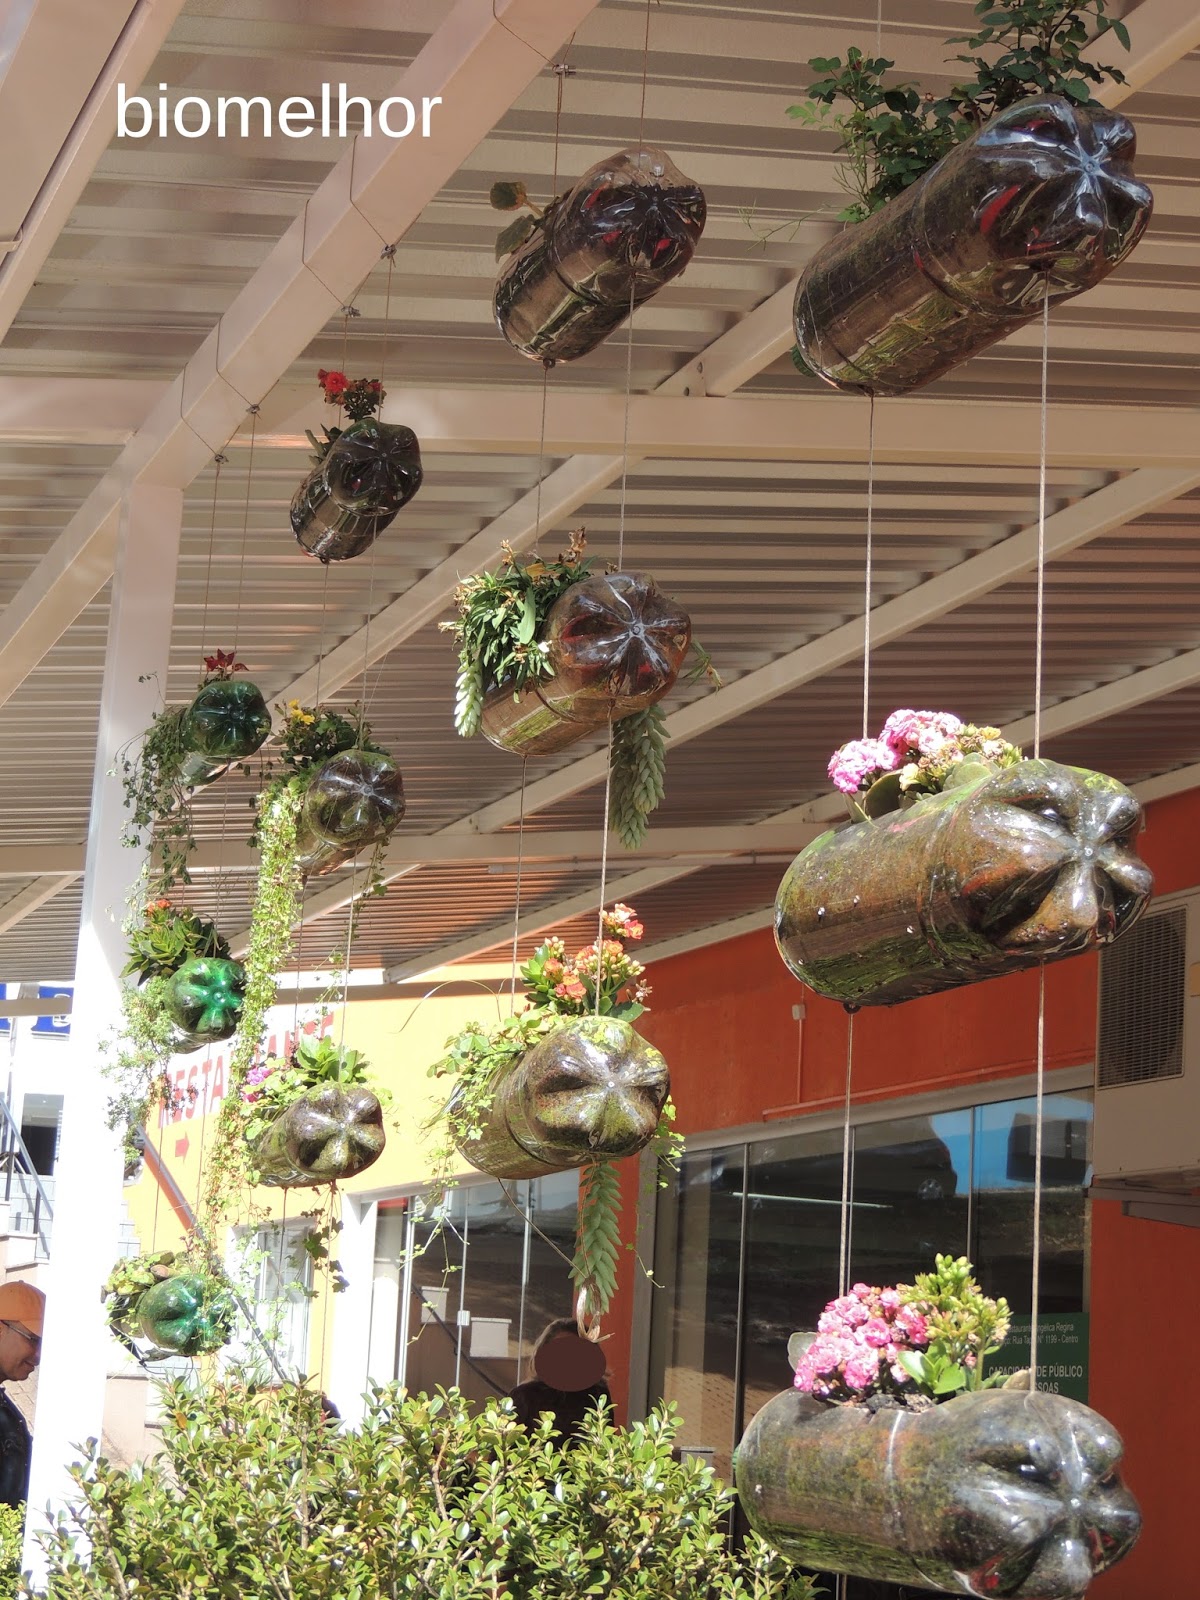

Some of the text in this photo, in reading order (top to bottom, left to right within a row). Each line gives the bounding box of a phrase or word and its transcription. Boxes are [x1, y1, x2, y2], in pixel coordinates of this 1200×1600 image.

[1036, 1323, 1055, 1334] ngélica
[1056, 1322, 1074, 1333] Regina
[1012, 1335, 1023, 1344] Rua
[1045, 1335, 1057, 1344] 1199
[1062, 1334, 1079, 1344] Centro
[1036, 1366, 1047, 1377] DE
[1048, 1362, 1083, 1378] PÚBLICO
